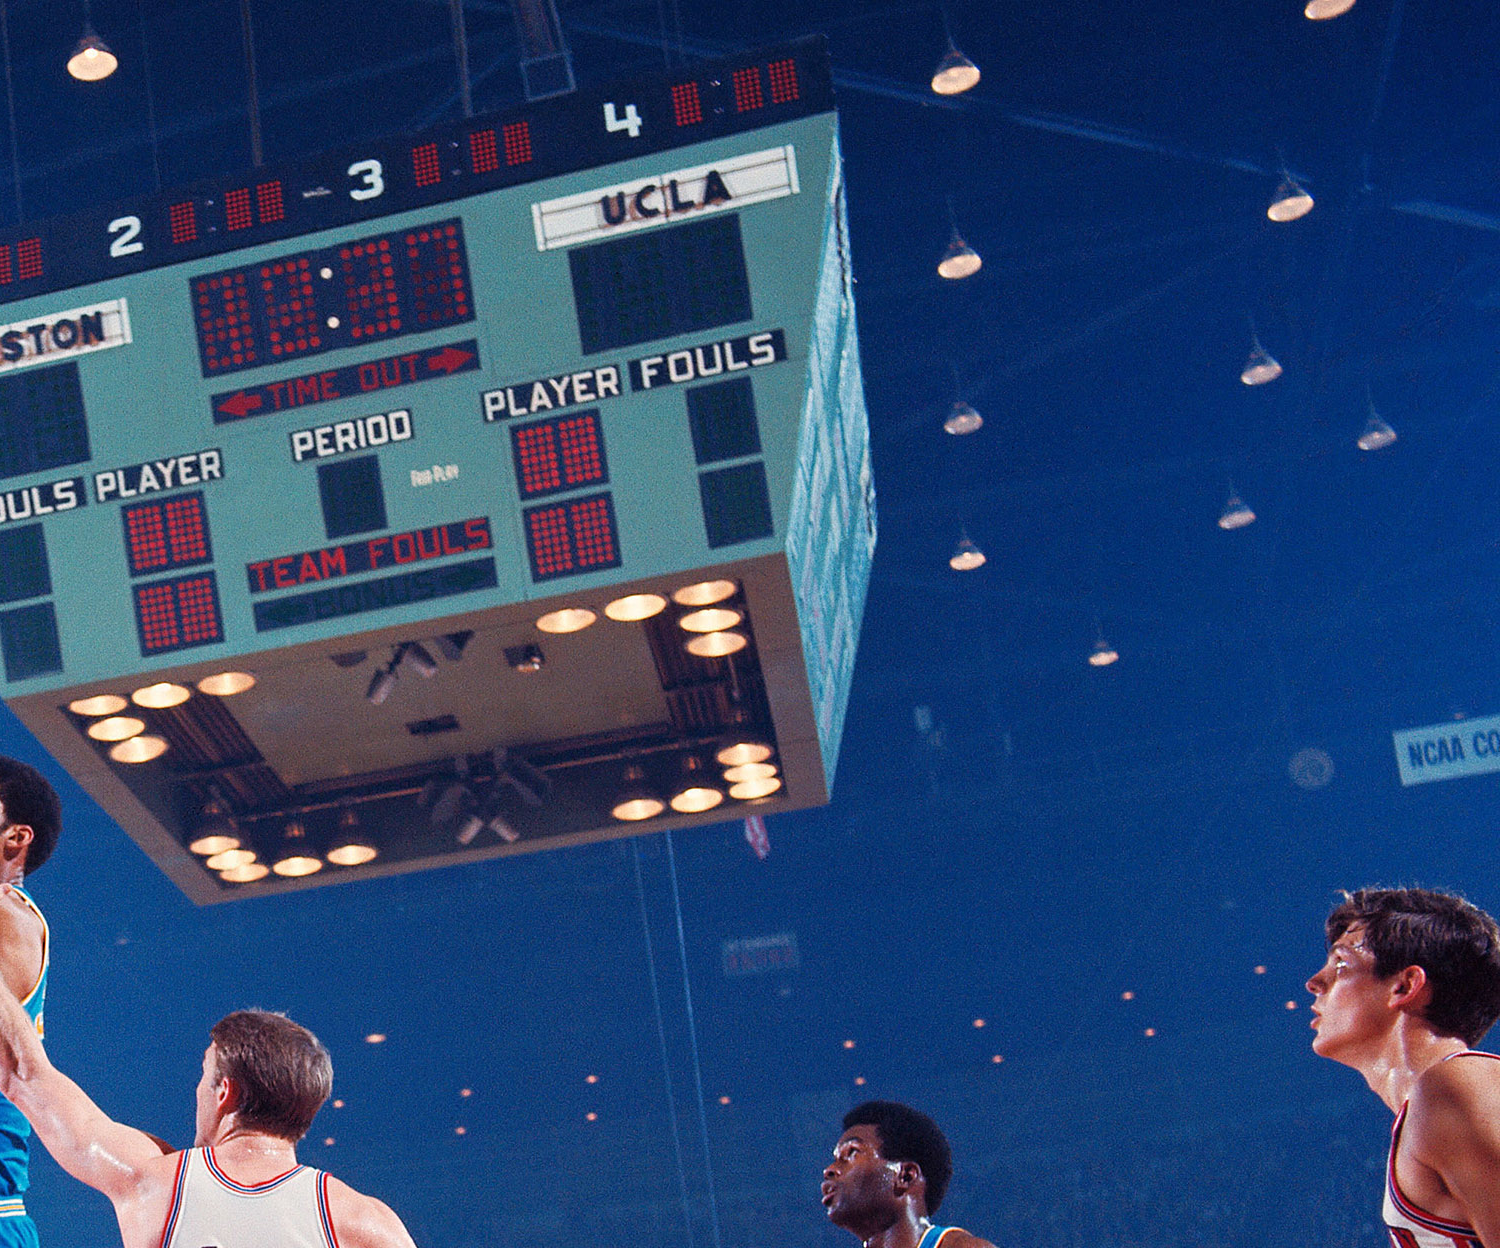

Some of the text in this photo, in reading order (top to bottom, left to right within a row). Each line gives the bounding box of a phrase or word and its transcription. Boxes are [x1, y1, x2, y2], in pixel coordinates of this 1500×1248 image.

[603, 102, 642, 137] 4
[348, 159, 384, 200] 3
[599, 171, 731, 226] UCLA
[108, 216, 143, 257] 2
[267, 354, 420, 411] TIME OUT
[483, 333, 775, 422] PLAYER FOULS
[291, 410, 412, 462] PERIOD
[95, 450, 221, 502] PLAYER
[250, 547, 347, 592] TEAM
[368, 518, 490, 569] FOULS
[1407, 735, 1466, 768] NCAA
